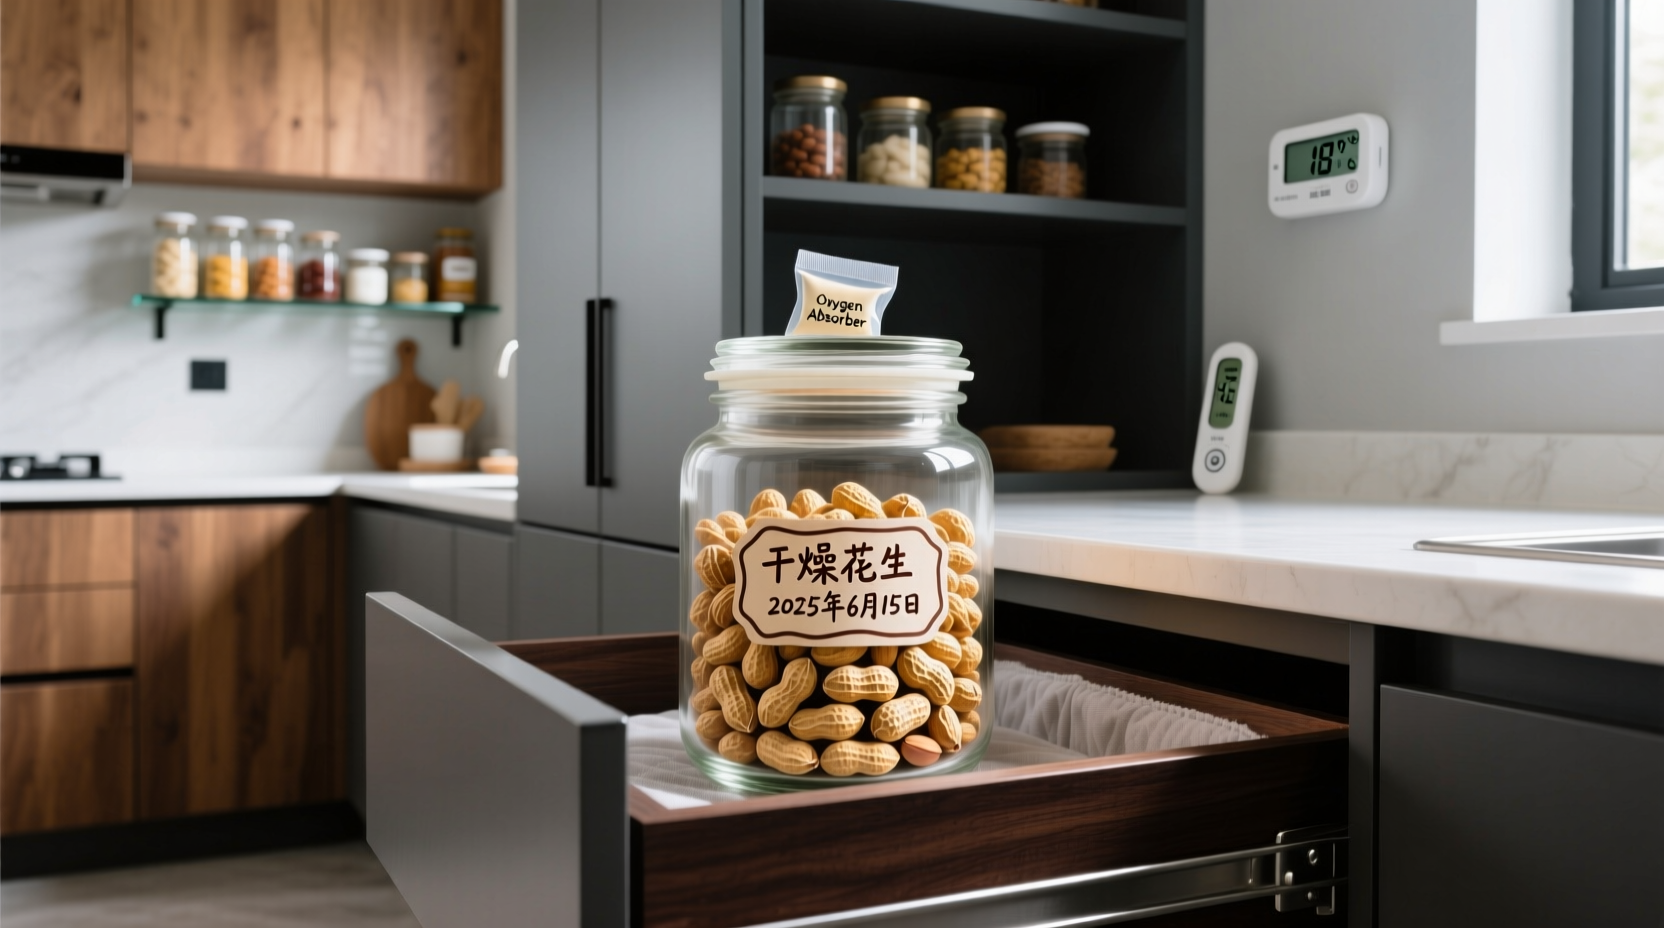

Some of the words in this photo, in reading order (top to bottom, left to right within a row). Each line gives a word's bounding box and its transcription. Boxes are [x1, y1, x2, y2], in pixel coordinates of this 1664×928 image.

[806, 308, 867, 328] Absorber
[762, 542, 913, 585] 干燥花生
[767, 590, 919, 623] 2025年6月15日
